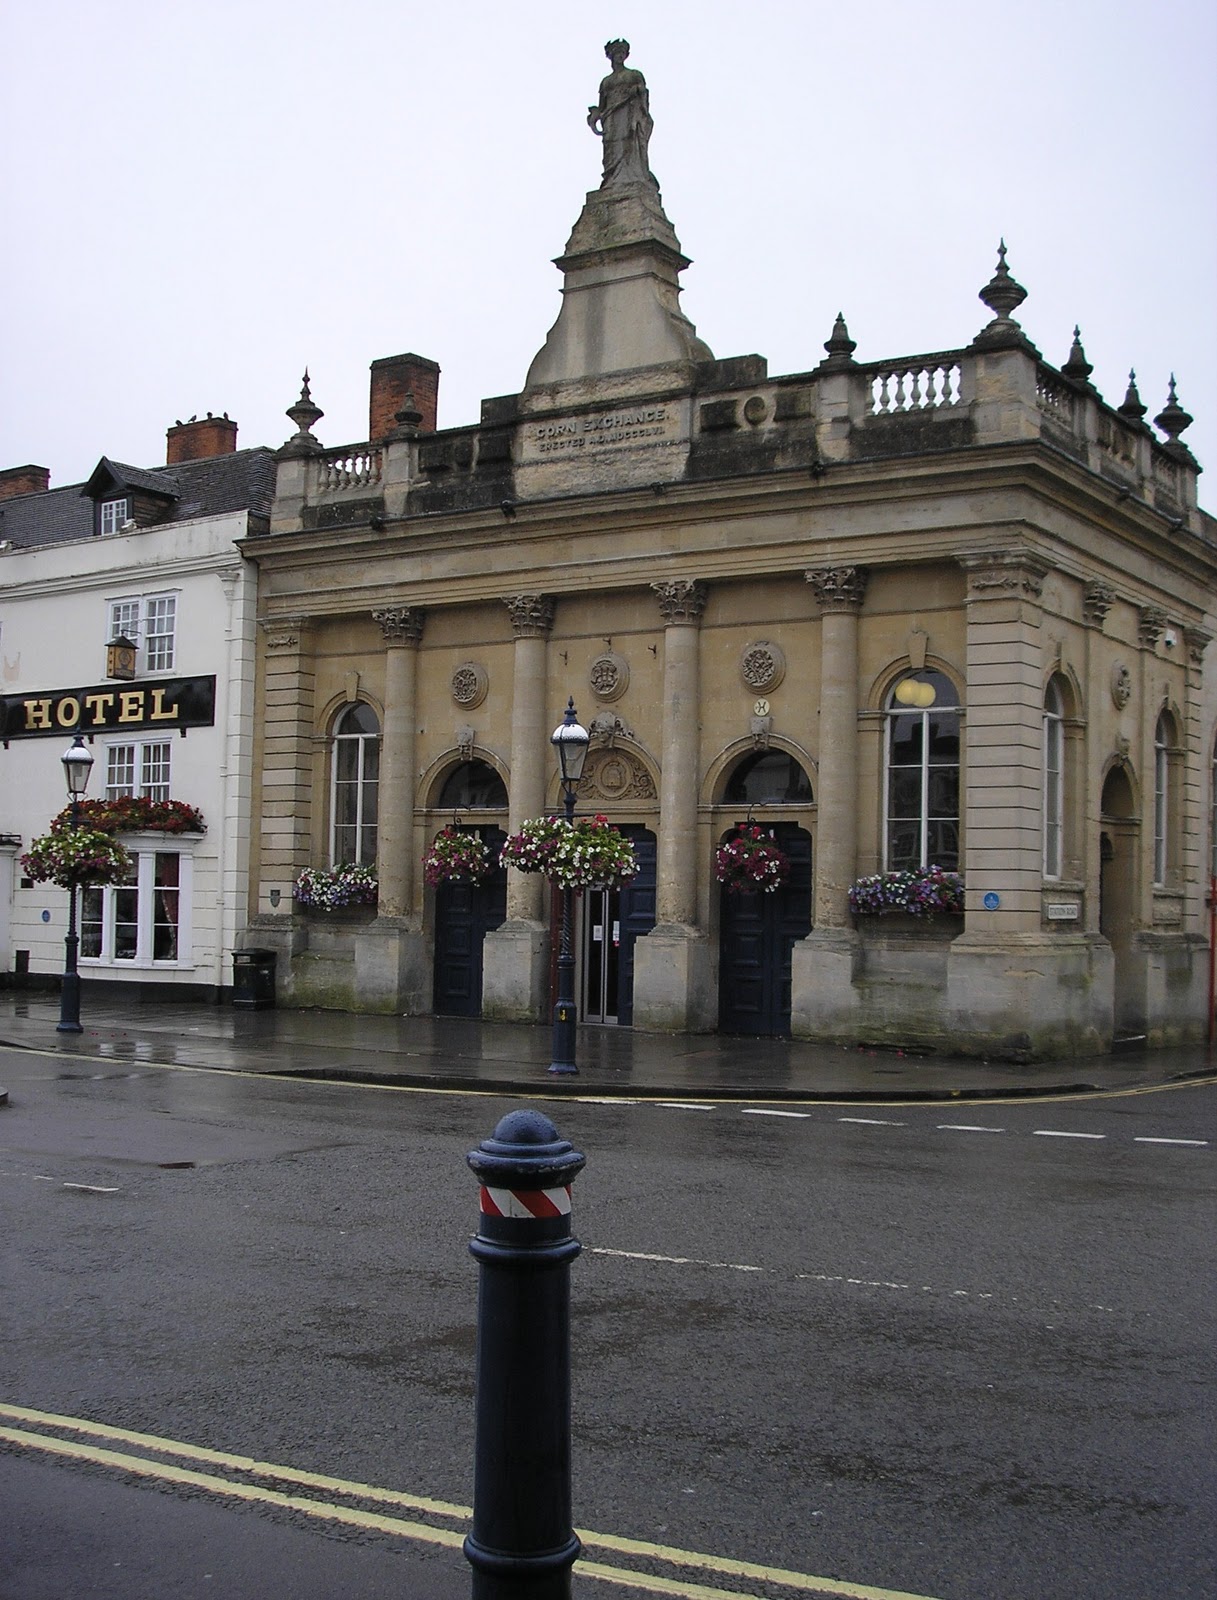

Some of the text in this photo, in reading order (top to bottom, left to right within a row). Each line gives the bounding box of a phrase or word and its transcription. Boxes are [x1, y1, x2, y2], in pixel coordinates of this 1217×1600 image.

[536, 421, 576, 439] CORN
[539, 437, 585, 452] ERECTED
[24, 688, 178, 729] HOTEL
